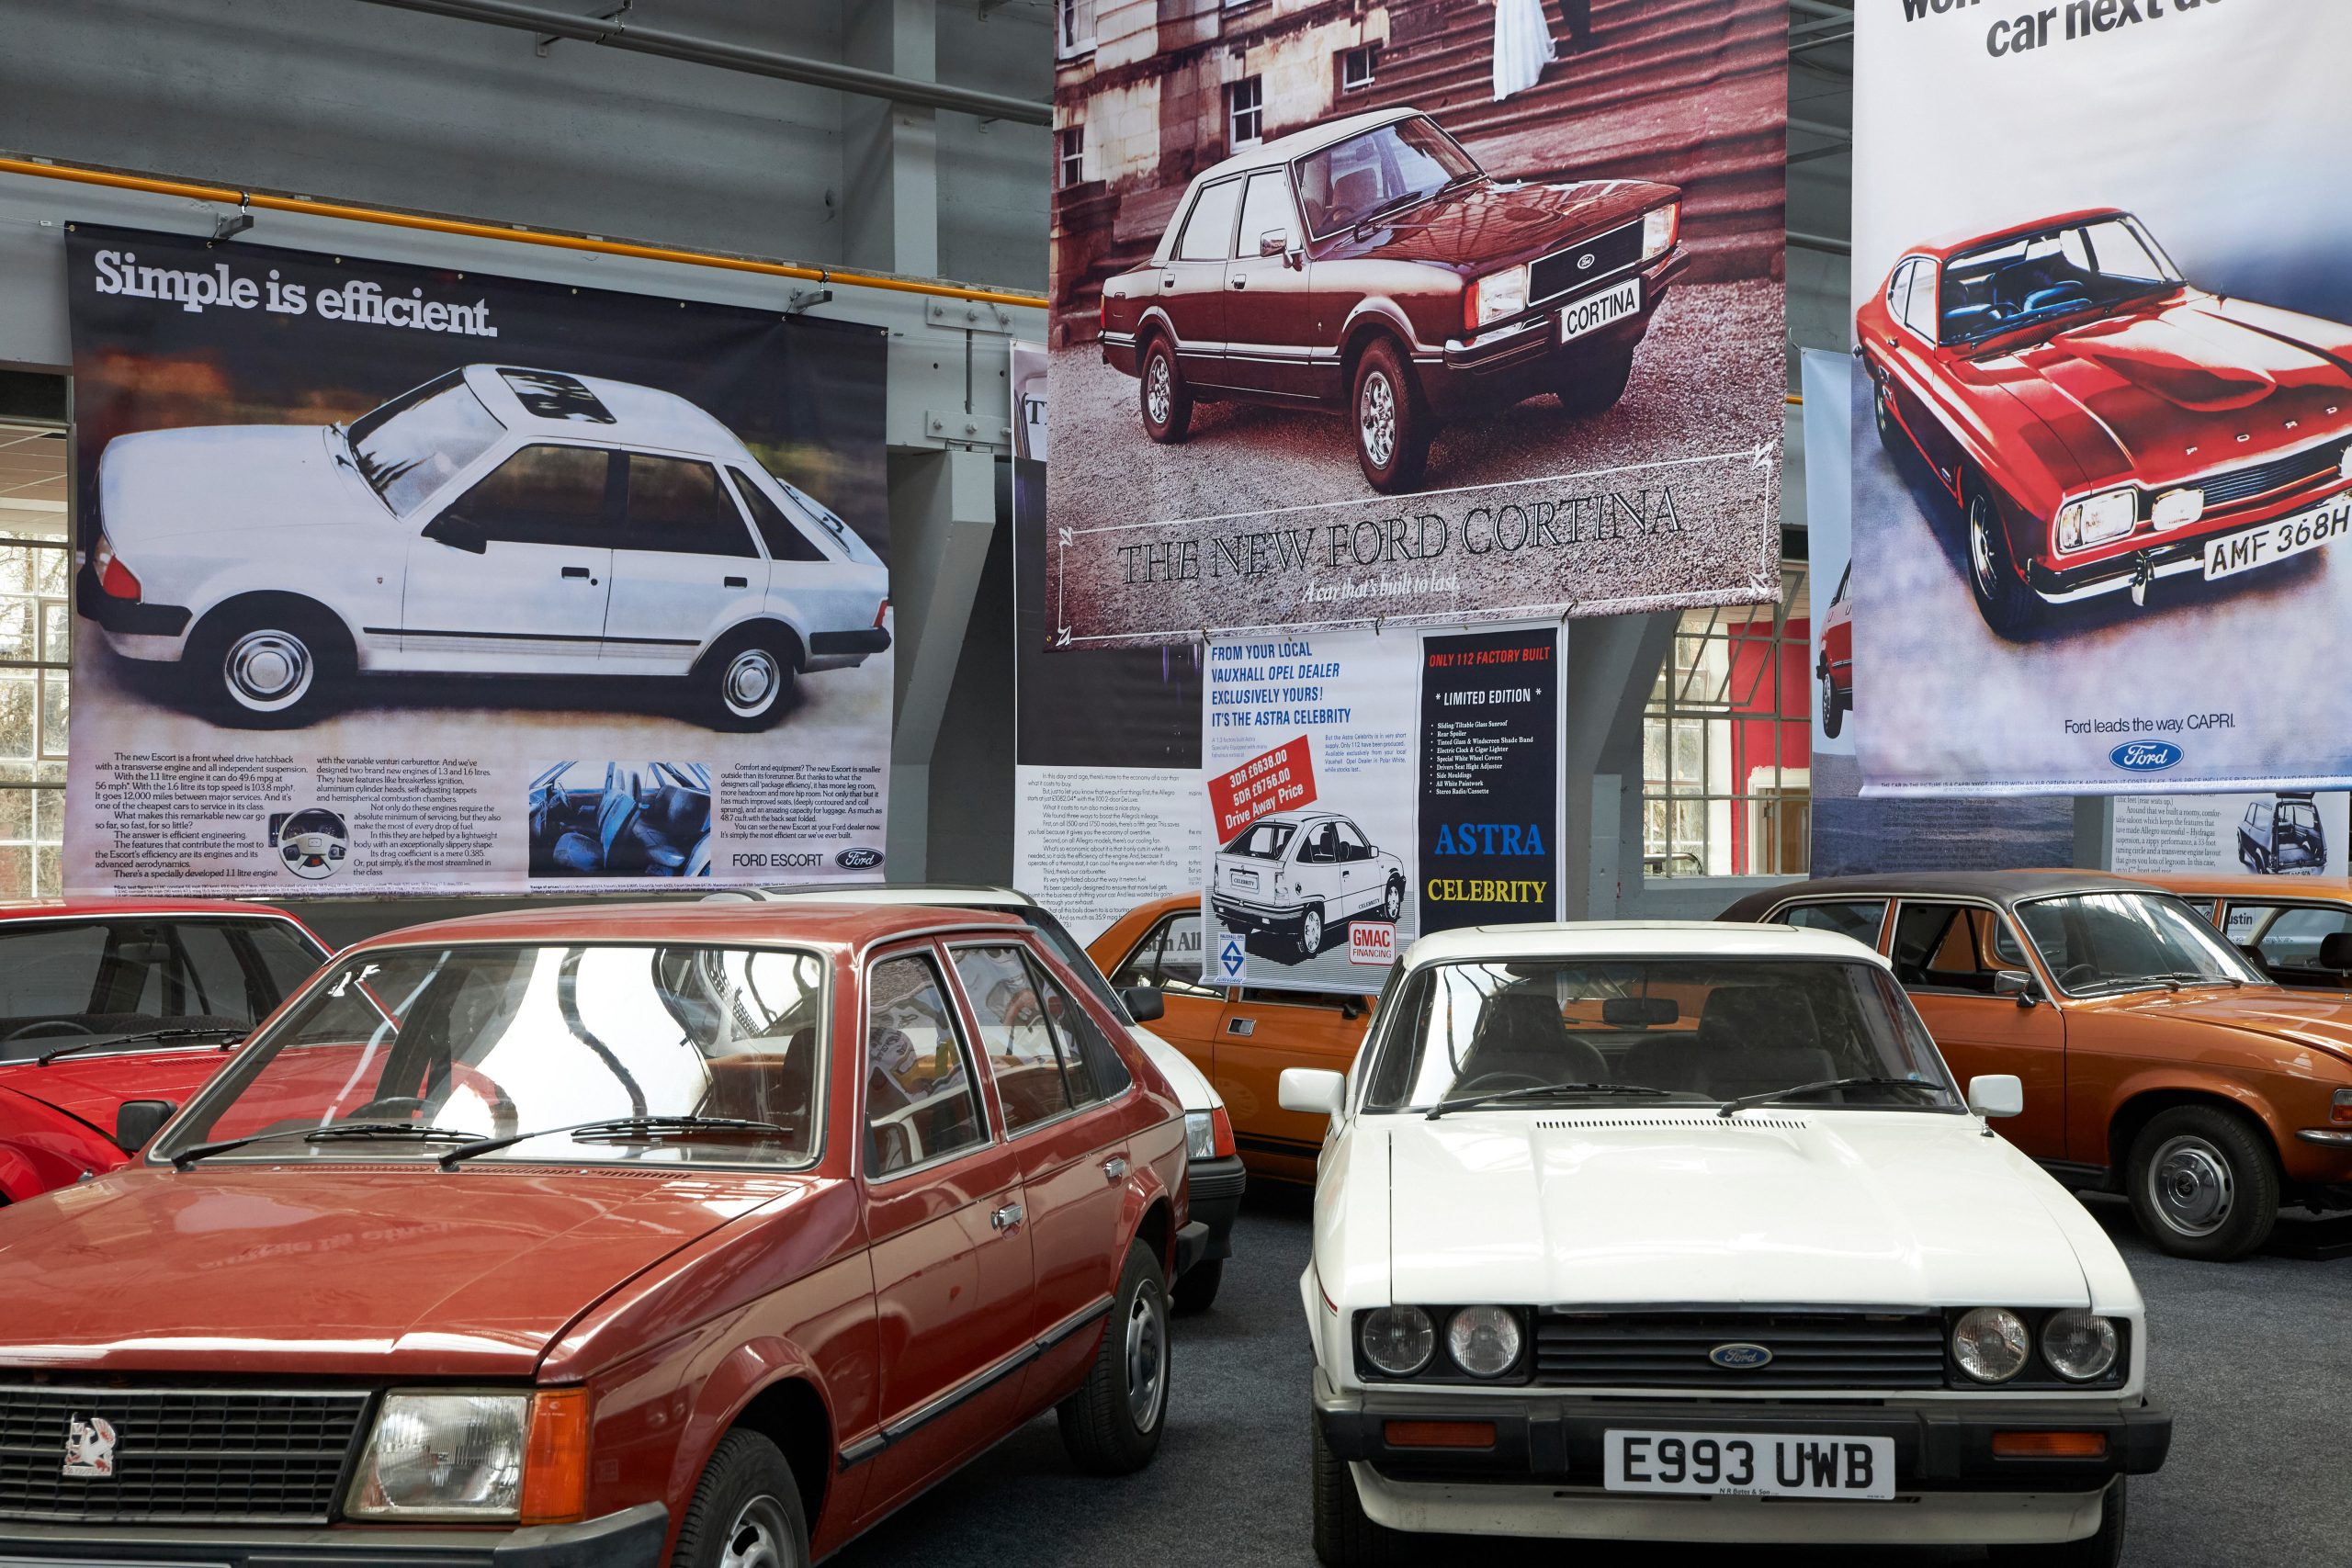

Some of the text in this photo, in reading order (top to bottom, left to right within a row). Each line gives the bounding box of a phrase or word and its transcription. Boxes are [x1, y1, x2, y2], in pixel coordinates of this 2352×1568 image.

[1986, 8, 2056, 58] car
[96, 251, 497, 336] Simple is efficient.
[1567, 288, 1635, 334] CORTINA
[1117, 486, 1682, 584] THE NEW FORD CORTINA
[2211, 505, 2350, 575] AMF 368H
[1302, 569, 1460, 602] A car that's built to last.
[1212, 642, 1312, 660] FROM YOUR LOCAL
[1430, 647, 1550, 667] ONLY 112 FACTORY BUILT
[1212, 663, 1340, 682] VAUXHALL OPEL DEALER
[1213, 687, 1323, 705] EXCLUSIVELY YOURS!
[1444, 688, 1531, 705] LIMITED EDITION
[1213, 708, 1351, 727] IT'S THE ASTRA CELEBRITY
[2064, 714, 2235, 734] Ford leads the way. CAPRI.
[114, 752, 130, 761] The
[255, 755, 293, 763] hatchback
[2123, 744, 2167, 765] Ford
[96, 762, 112, 771] with
[164, 764, 190, 773] engine
[219, 764, 264, 773] independent
[266, 765, 307, 773] suspension.
[772, 764, 804, 773] equipment?
[1229, 750, 1287, 787] 3DR £6638.00
[1233, 768, 1290, 806] 5DR £6756.00
[1226, 784, 1303, 829] Drive Away Price
[2146, 807, 2156, 815] that
[2166, 807, 2177, 816] built
[1434, 822, 1544, 856] ASTRA
[732, 854, 823, 866] FORD ESCORT
[845, 852, 874, 865] Ford
[1234, 877, 1255, 886] CELEBRITY
[1428, 878, 1547, 903] CELEBRITY
[1358, 898, 1380, 908] CELEBRITY
[1353, 930, 1391, 948] GMAC
[1352, 949, 1392, 958] FINANCING
[1724, 1348, 1757, 1362] Ford
[1623, 1437, 1872, 1488] E993 UWB
